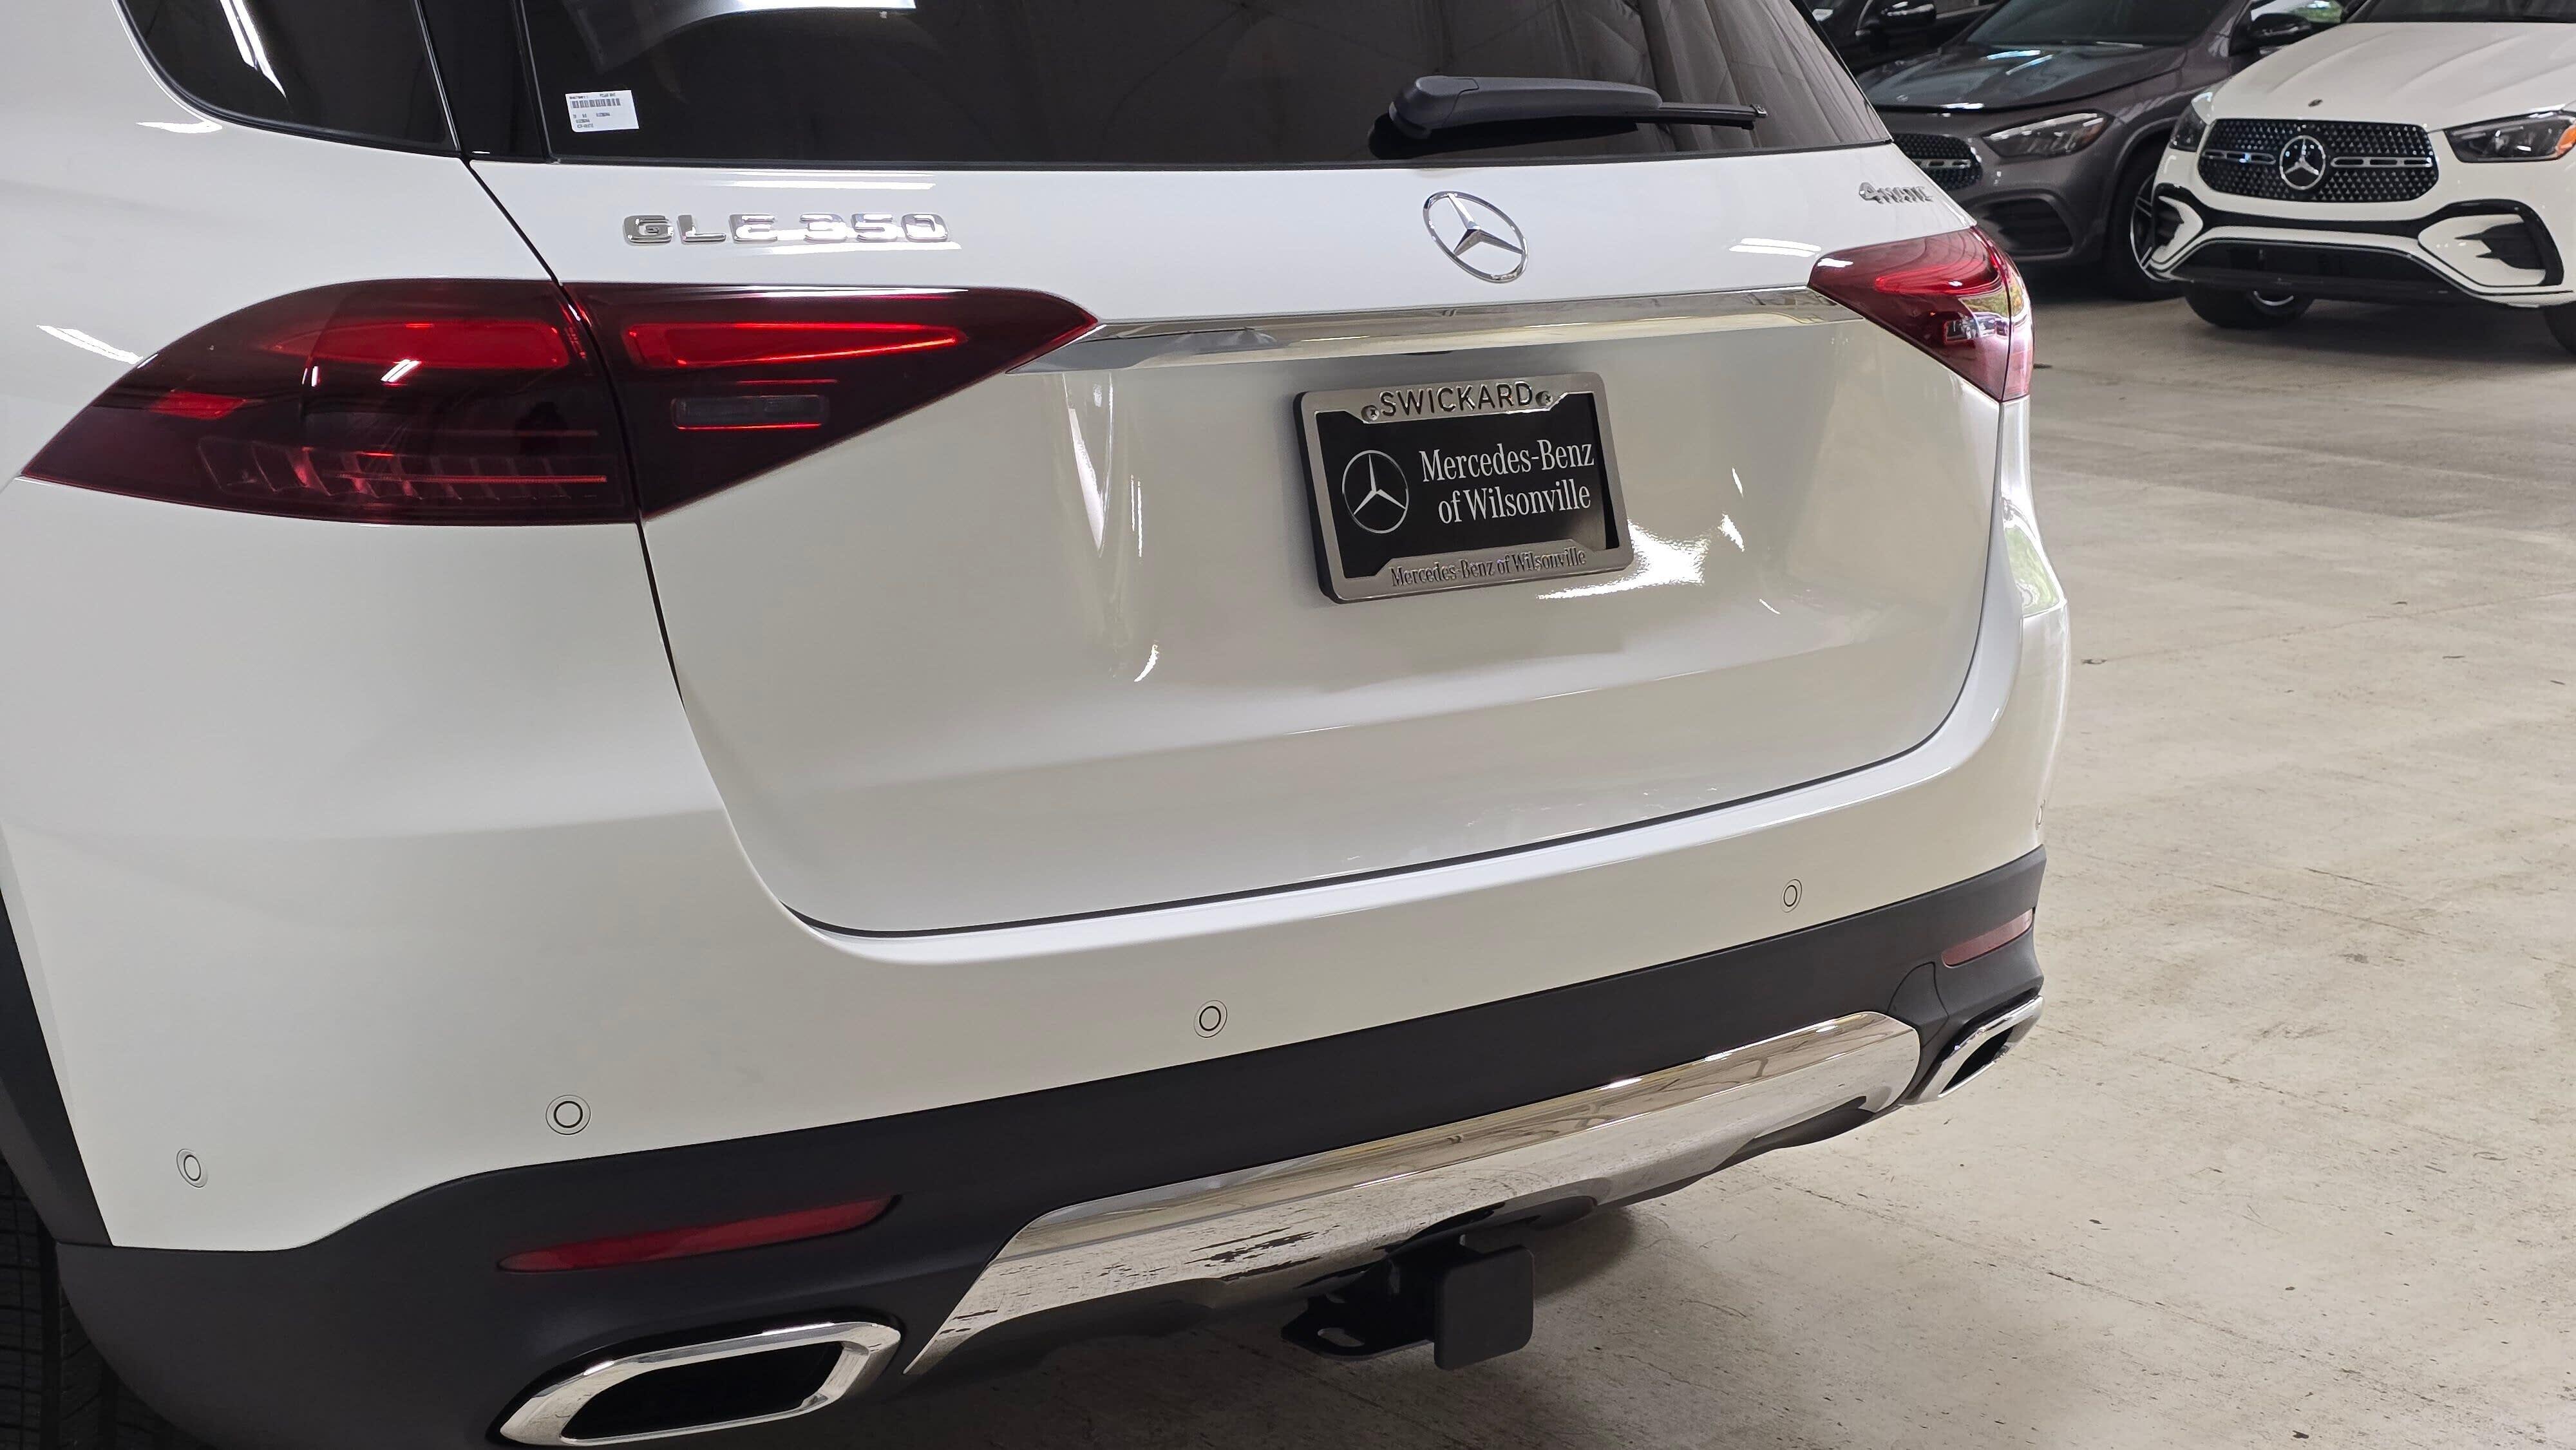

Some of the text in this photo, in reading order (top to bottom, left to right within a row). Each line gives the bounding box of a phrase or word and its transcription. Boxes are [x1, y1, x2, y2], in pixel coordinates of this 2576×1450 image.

[623, 213, 950, 245] GLE 350
[1379, 381, 1533, 417] SWICKARD
[1418, 439, 1595, 482] Mercedes-Benz
[1438, 478, 1591, 523] of Wilsonville
[1390, 546, 1587, 587] Mercedes-Benz of Wilsonville
